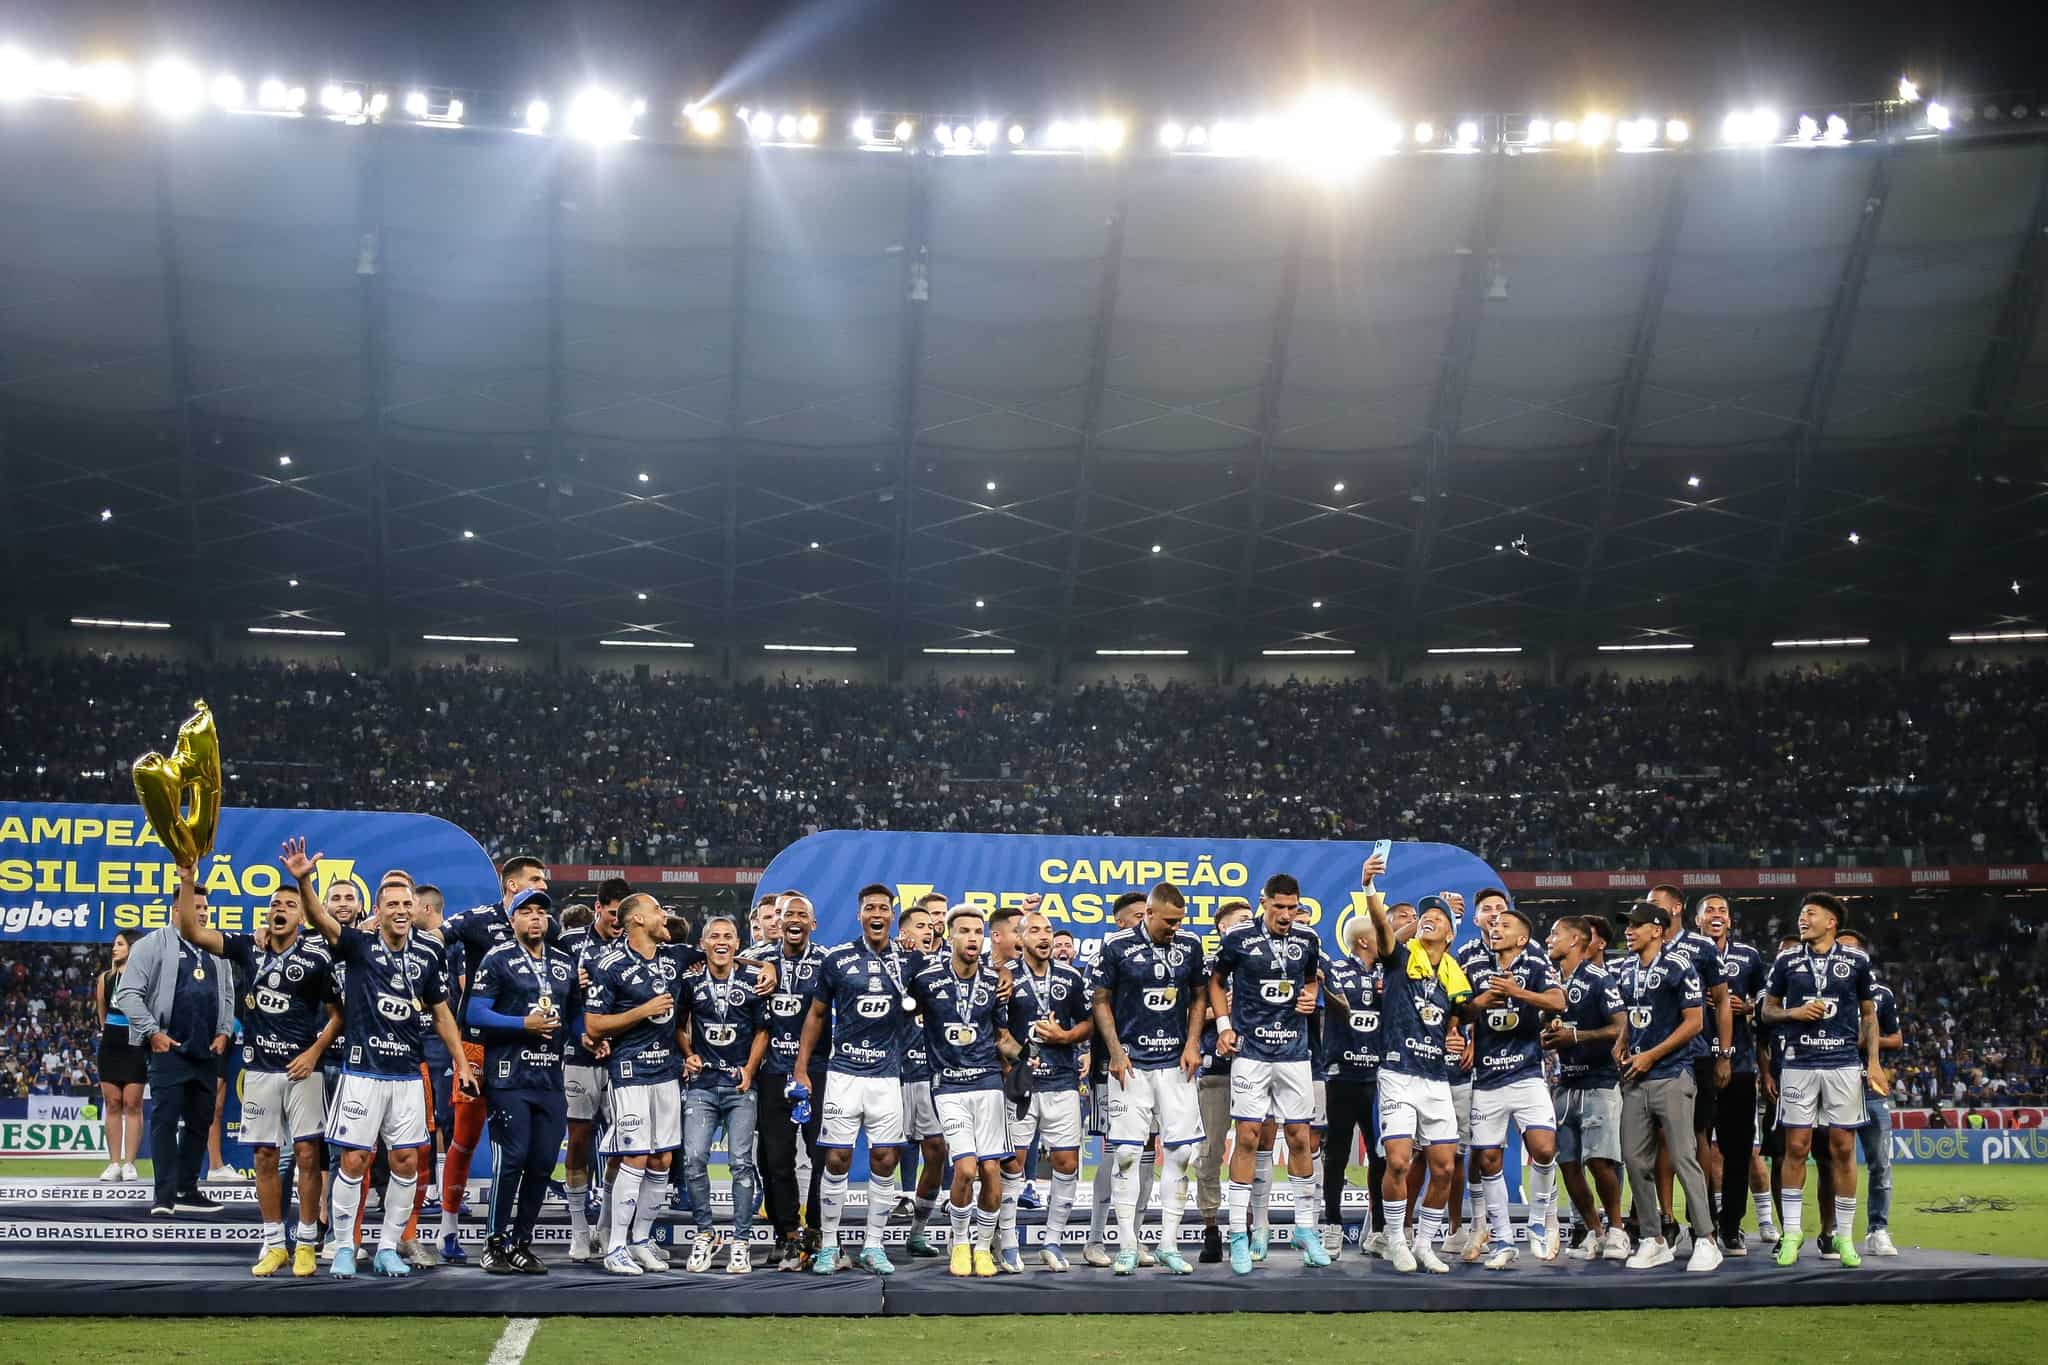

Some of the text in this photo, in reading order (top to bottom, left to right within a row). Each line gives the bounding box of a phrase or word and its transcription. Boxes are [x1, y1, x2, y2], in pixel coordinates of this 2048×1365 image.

[662, 872, 699, 882] BRAHMA
[1039, 854, 1249, 888] CAMPEÃO
[1911, 870, 1950, 882] BRAHMA
[1535, 875, 1572, 886] BRAHMA
[1608, 875, 1647, 886] BRAHMA
[1682, 874, 1721, 885] BRAHMA
[1758, 873, 1797, 884] BRAHMA
[1834, 872, 1873, 884] BRAHMA
[259, 993, 285, 1010] BH
[861, 1002, 887, 1013] BH
[381, 1002, 407, 1017] BH
[1353, 1016, 1376, 1027] BH
[1255, 1026, 1298, 1041] Champion
[369, 1036, 411, 1052] Champion
[1138, 1035, 1180, 1048] Champion
[1405, 1037, 1443, 1056] Champio
[1800, 1034, 1845, 1048] Champion
[842, 1043, 886, 1058] Champion
[1482, 1053, 1524, 1068] Champion
[1888, 1130, 1969, 1160] ixbet
[41, 1186, 90, 1199] SÉRIE
[93, 1188, 102, 1198] B
[106, 1189, 147, 1199] 2022
[1344, 1193, 1353, 1201] B
[36, 1227, 148, 1239] BRASILEIRO
[152, 1226, 206, 1239] SÉRIE
[210, 1228, 221, 1239] B
[936, 1230, 946, 1241] B
[1278, 1229, 1289, 1241] B
